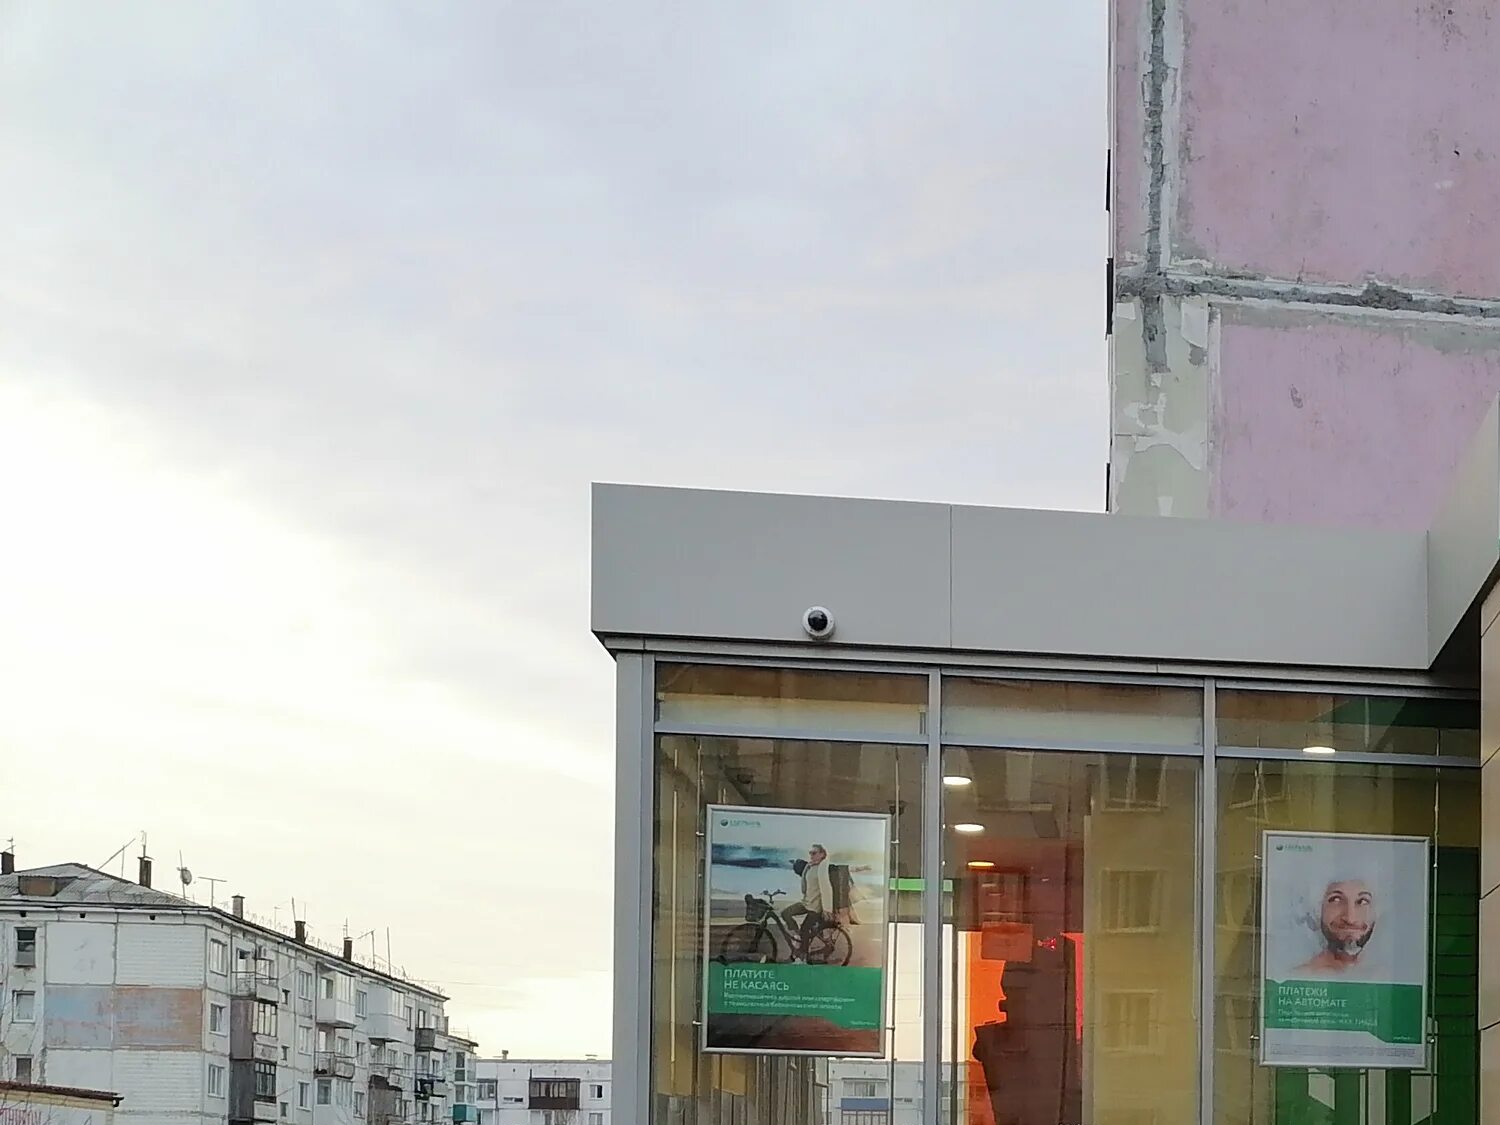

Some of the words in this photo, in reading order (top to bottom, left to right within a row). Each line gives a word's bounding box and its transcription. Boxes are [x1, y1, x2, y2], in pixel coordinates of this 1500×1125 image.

[724, 968, 775, 979] ПЛАТИТЕ
[724, 980, 739, 989] НЕ
[741, 980, 790, 991] КАСАЯСЬ
[1278, 986, 1328, 997] ПЛАТЕЖИ
[1278, 997, 1294, 1006] НА
[1294, 998, 1347, 1008] АВТОМАТЕ
